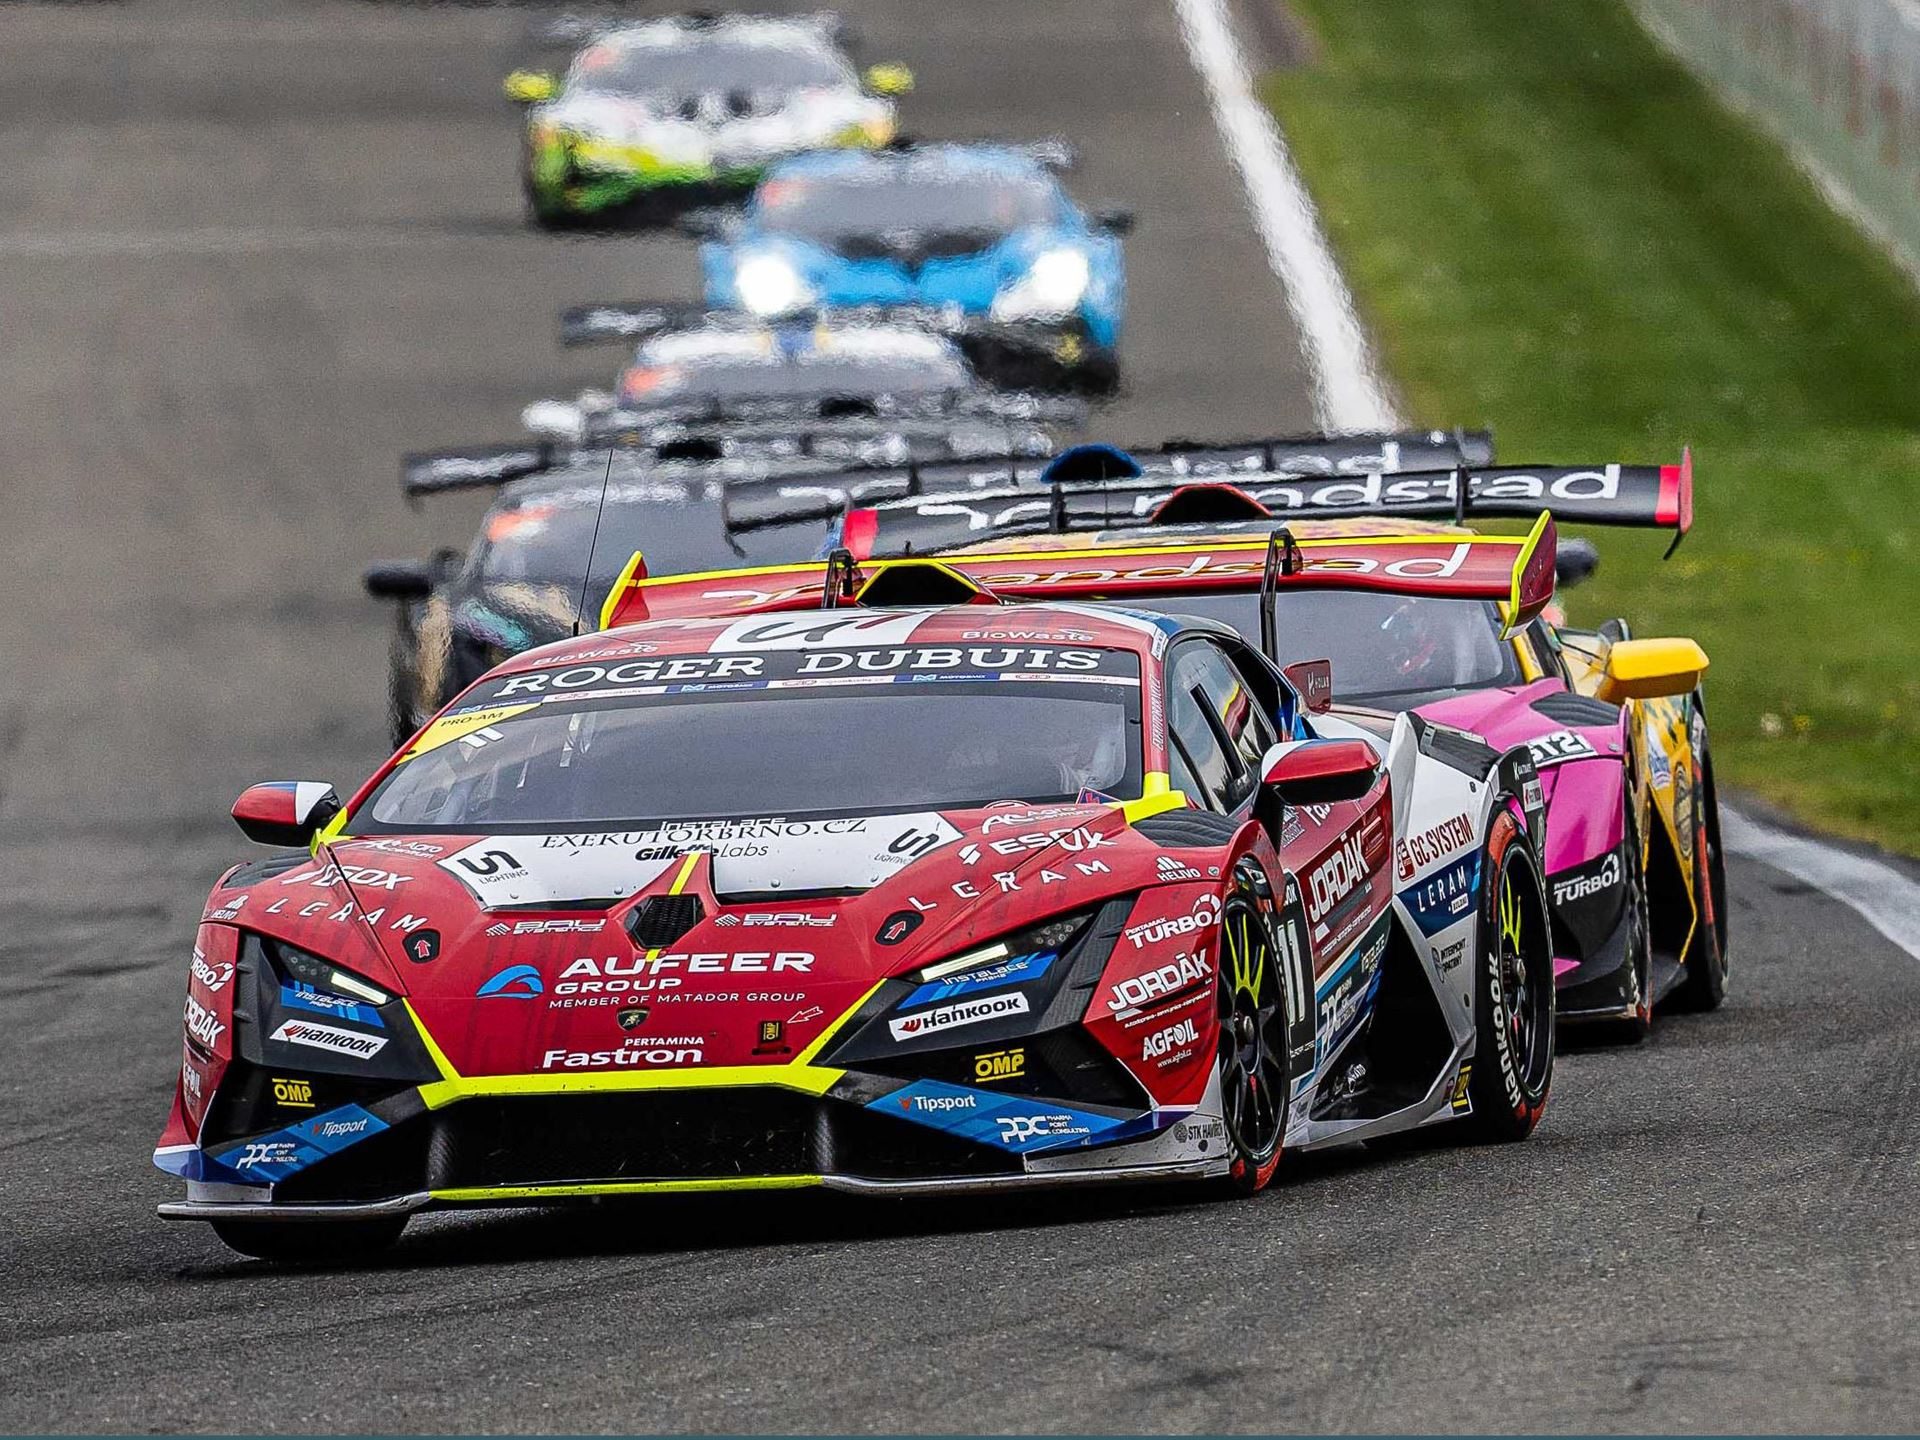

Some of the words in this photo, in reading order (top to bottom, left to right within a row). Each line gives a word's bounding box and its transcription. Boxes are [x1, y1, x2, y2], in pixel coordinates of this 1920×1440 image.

[962, 630, 1095, 642] BioWaste
[492, 656, 765, 698] ROGER
[797, 647, 1102, 673] DUBUIS
[441, 711, 504, 728] PRO-AM
[540, 819, 868, 848] EXEKUTORBRNO.CZ
[1410, 834, 1431, 867] GC
[1425, 812, 1475, 860] SYSTEM
[478, 869, 529, 886] LIGHTING
[908, 860, 1111, 912] LERAM
[1553, 870, 1614, 906] TURBO
[1417, 865, 1467, 913] LERAM
[265, 897, 428, 934] LERAM
[1125, 917, 1168, 937] PERTAMAX
[1127, 911, 1217, 950] TURBO
[558, 952, 816, 979] AUFEER
[554, 978, 682, 995] GROUP
[549, 996, 620, 1009] MEMBER
[627, 995, 651, 1005] OF
[657, 992, 739, 1004] MATADOR
[747, 992, 806, 1002] GROUP
[624, 1036, 705, 1047] PERTAMINA
[1142, 1018, 1200, 1062] AGFOIL
[543, 1048, 703, 1069] Fastron
[975, 1053, 1025, 1077] OMP
[274, 1083, 313, 1102] OMP
[914, 1095, 977, 1113] Tipsport
[321, 1117, 369, 1137] Tipsport
[995, 1115, 1051, 1144] PPC
[1188, 1125, 1202, 1140] STK
